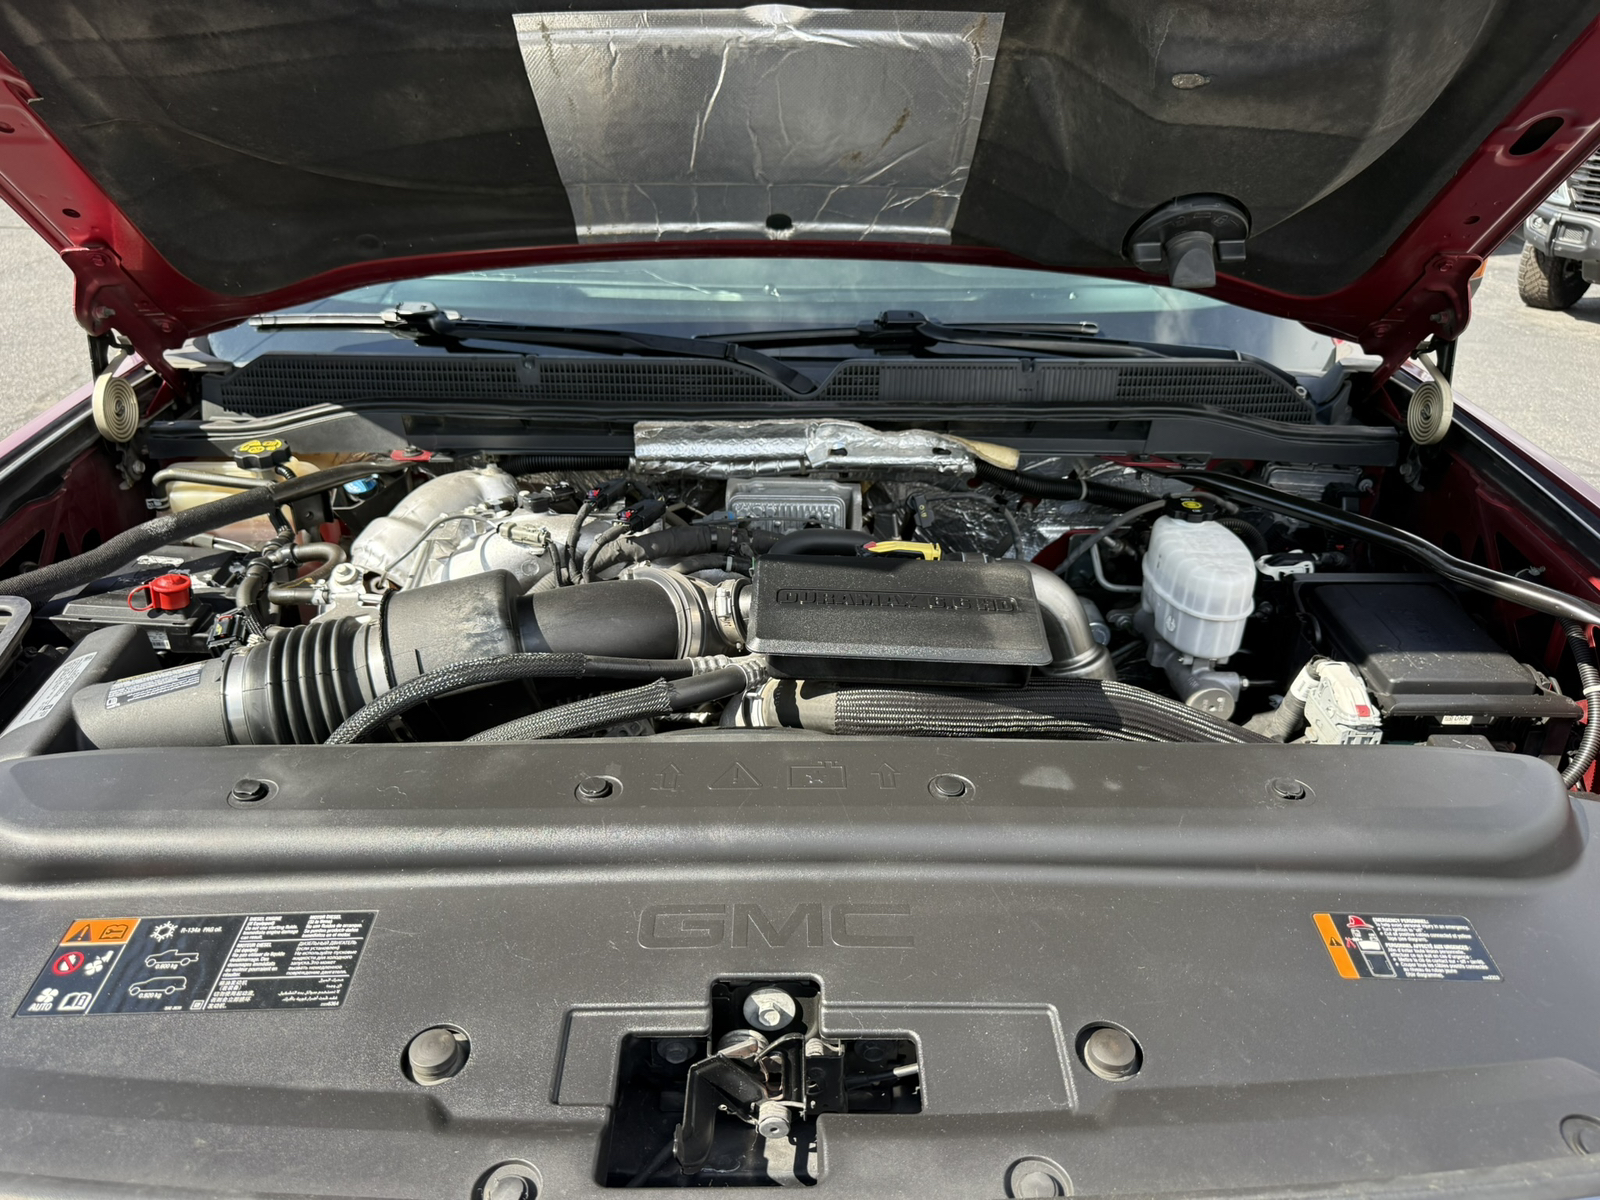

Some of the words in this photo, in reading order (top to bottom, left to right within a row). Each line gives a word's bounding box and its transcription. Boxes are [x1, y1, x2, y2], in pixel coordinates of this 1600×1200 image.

[778, 591, 918, 608] DURAMAX
[976, 597, 1016, 612] HD
[637, 903, 915, 949] GMC
[28, 1003, 53, 1011] AUTO
